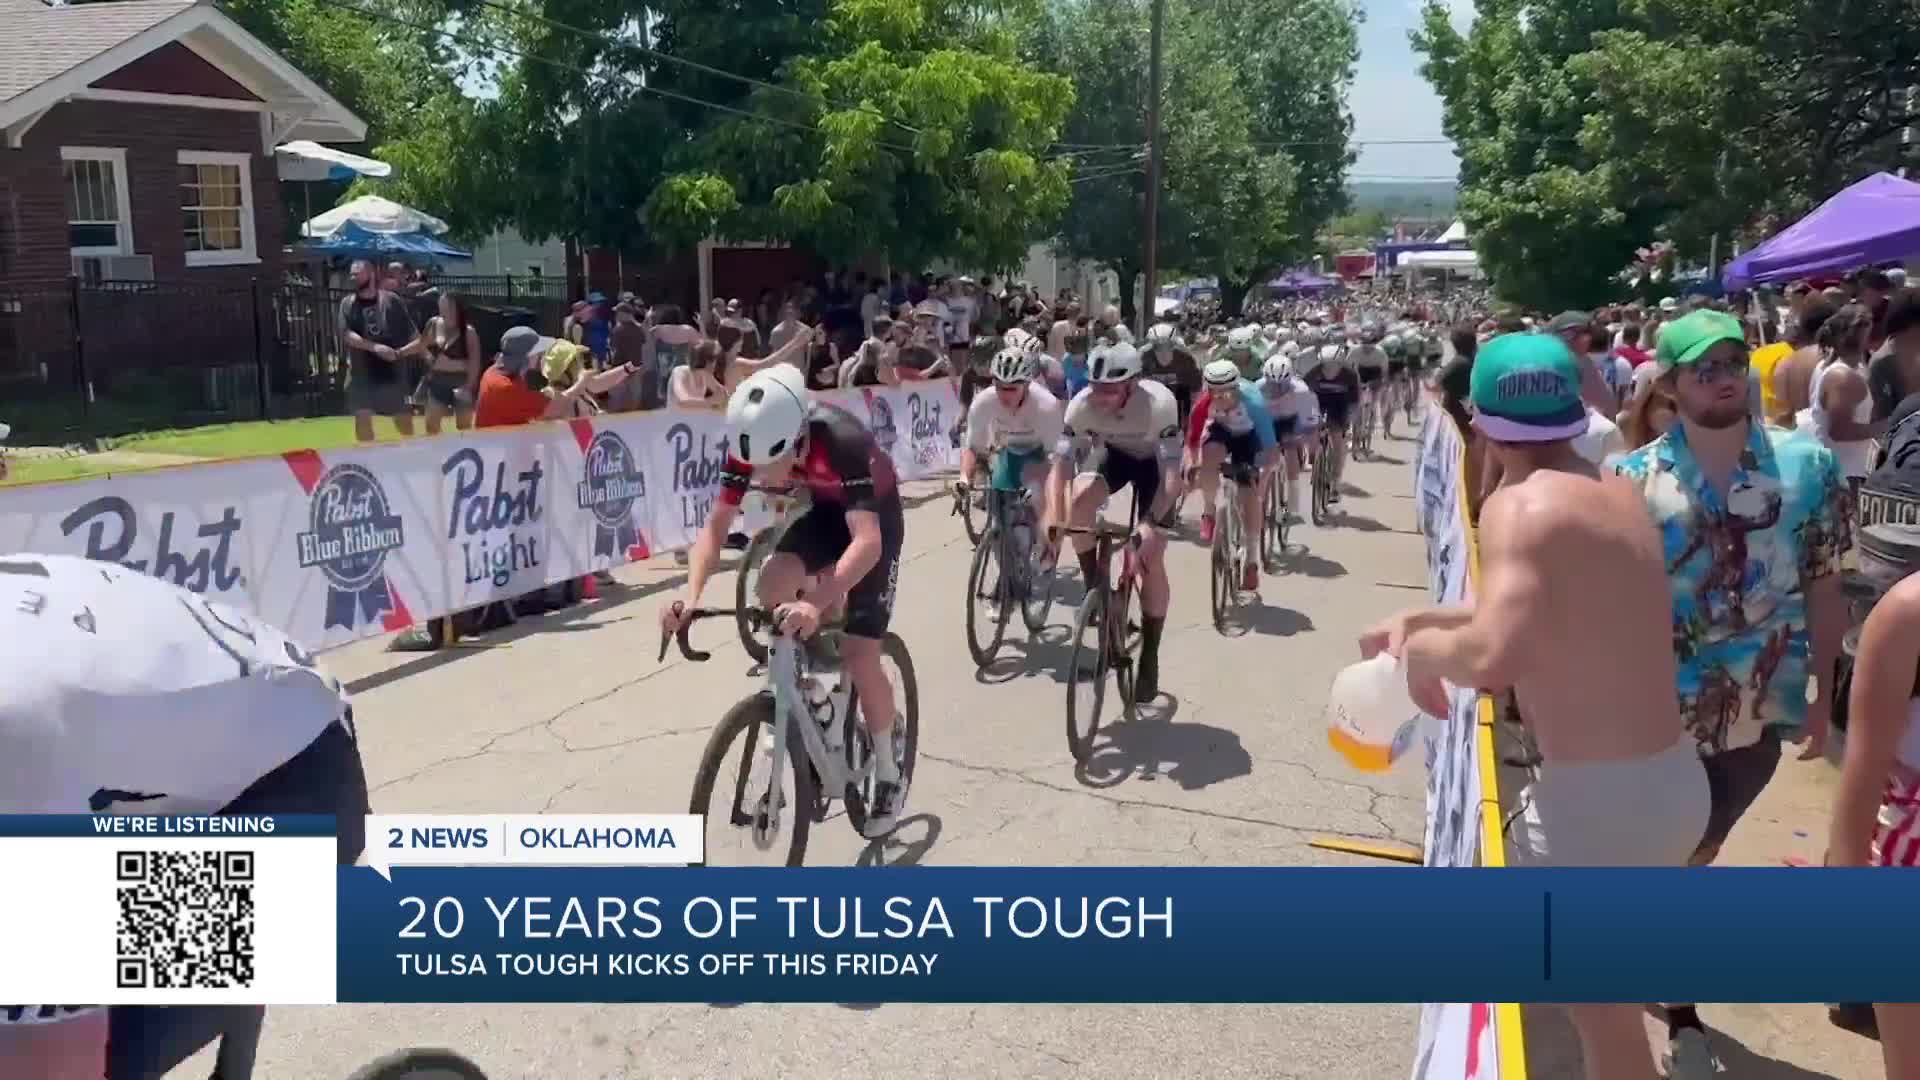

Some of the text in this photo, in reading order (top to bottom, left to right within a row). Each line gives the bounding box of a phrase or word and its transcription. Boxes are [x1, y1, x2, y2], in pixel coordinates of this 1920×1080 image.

[319, 483, 374, 525] Pabst
[442, 448, 543, 538] Pabst
[60, 496, 242, 592] Pbst
[301, 534, 341, 563] Blue
[342, 523, 400, 555] Ribbon
[462, 533, 540, 587] Light
